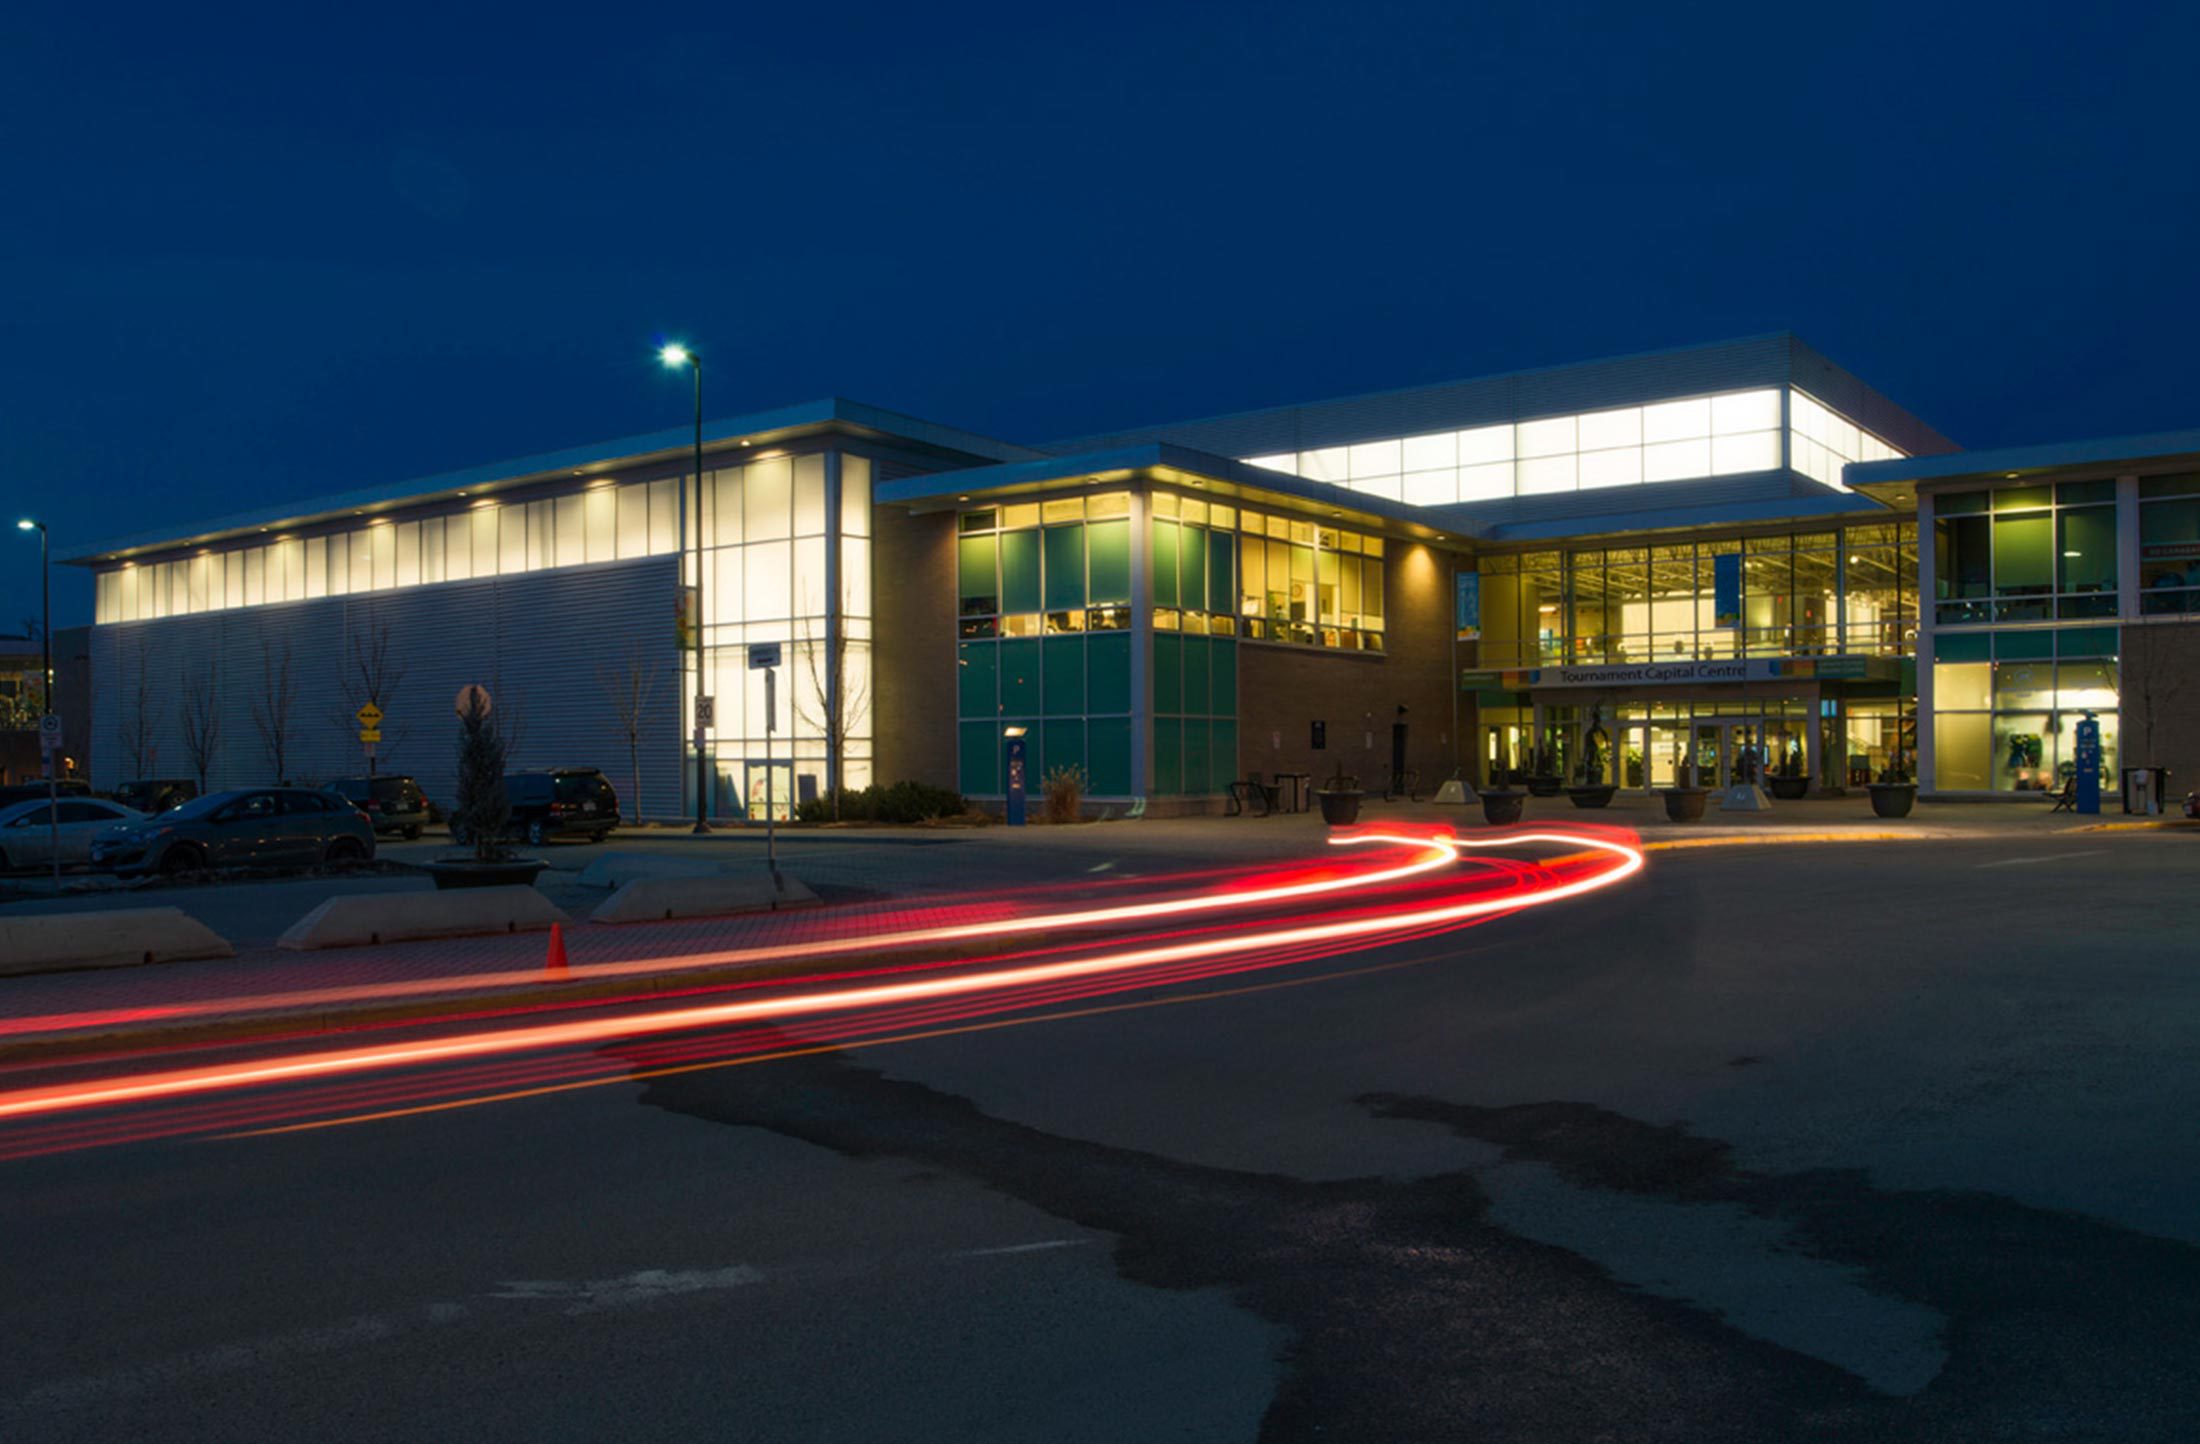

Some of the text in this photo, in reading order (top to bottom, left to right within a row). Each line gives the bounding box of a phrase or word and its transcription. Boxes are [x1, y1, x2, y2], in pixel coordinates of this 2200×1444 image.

[1560, 664, 1746, 682] Tournament Capital Centre
[697, 703, 713, 719] 20
[2083, 726, 2092, 736] P
[1012, 744, 1020, 755] P
